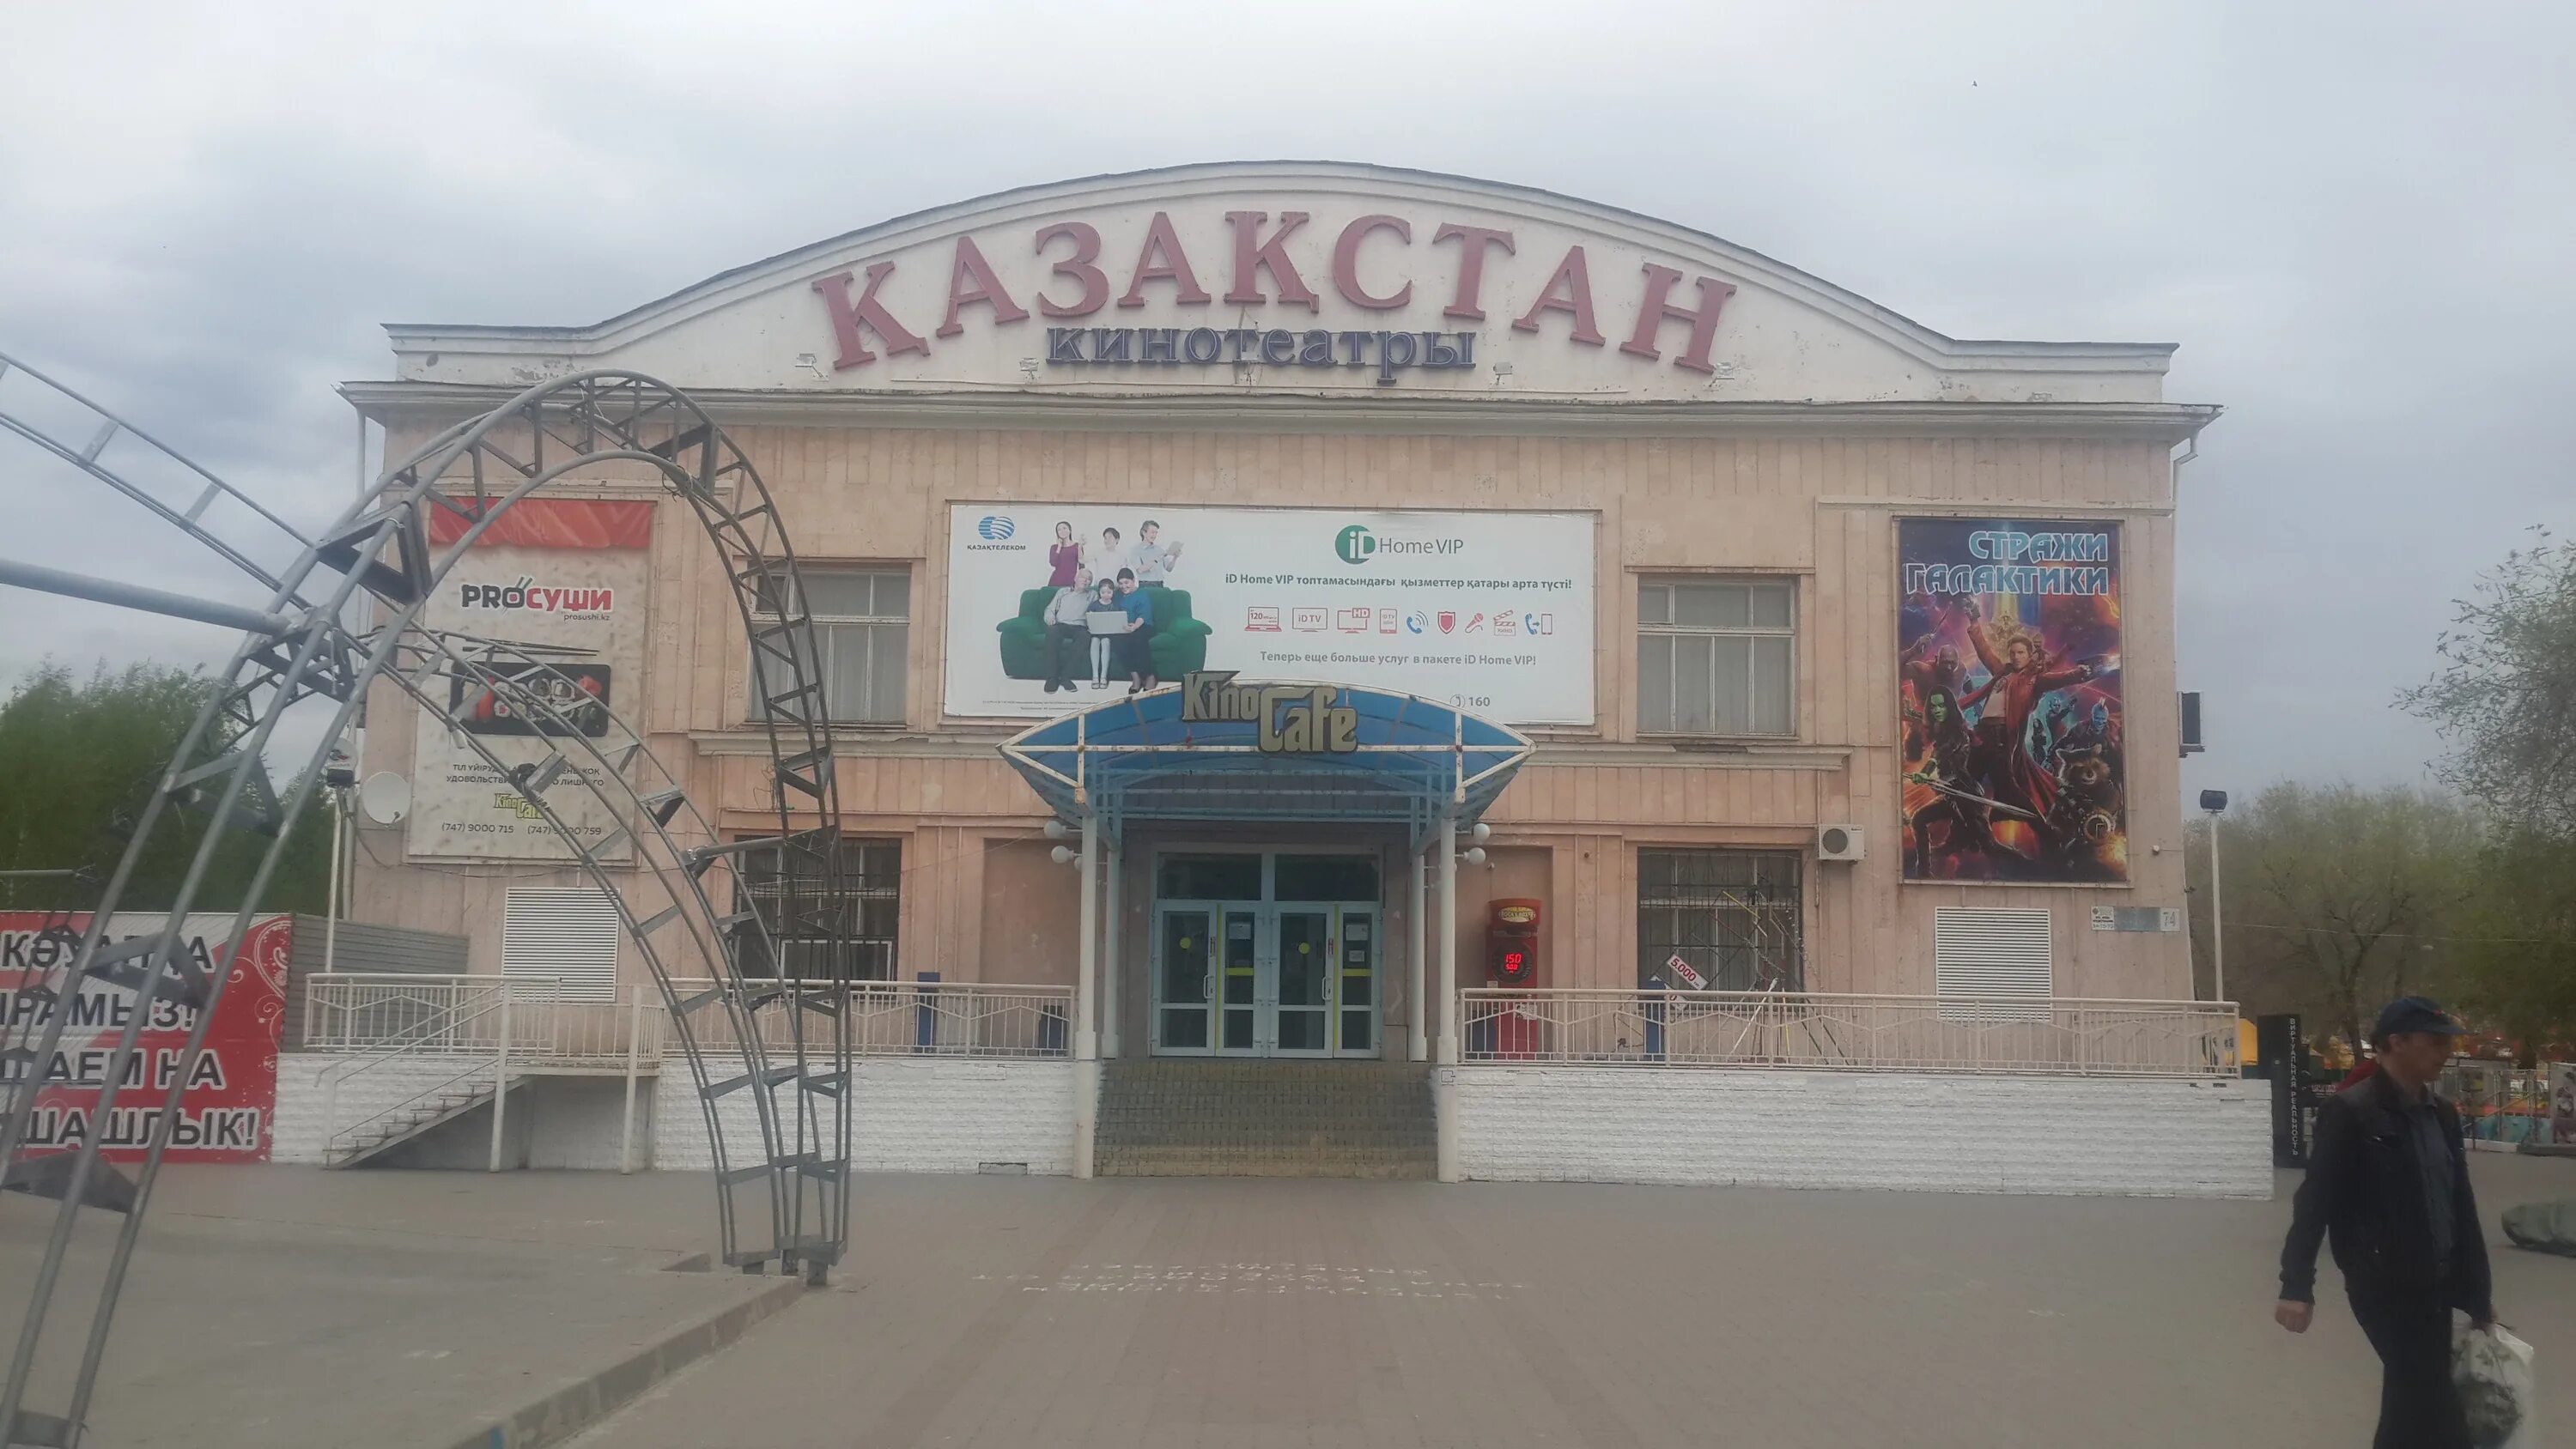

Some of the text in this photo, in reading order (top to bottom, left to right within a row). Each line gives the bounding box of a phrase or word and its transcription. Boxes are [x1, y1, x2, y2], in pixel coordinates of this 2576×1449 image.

[811, 211, 1738, 375] ҚАЗАҚСТАН
[1045, 326, 1477, 385] кинотеатры
[1379, 537, 1434, 554] Home
[1436, 539, 1464, 555] VIP
[1969, 530, 2108, 564] СТРАЖИ
[1225, 573, 1572, 591] iD Home VIP топтамасындағы қызметтер қатары арта түсті!
[1905, 563, 2109, 596] ГАЛАКТИКИ
[1352, 609, 1369, 618] HD
[1260, 652, 1303, 663] Теперь
[1304, 653, 1327, 664] еще
[1331, 652, 1376, 664] больше
[1378, 654, 1409, 665] услуг
[1422, 655, 1461, 664] пакете
[1464, 654, 1476, 664] iD
[1479, 655, 1512, 665] Home
[1514, 656, 1537, 666] VIP!
[1467, 697, 1491, 707] 160
[1182, 670, 1358, 753] Kino Cafe
[447, 775, 513, 784] УДОВОЛЬСТВИ
[441, 824, 465, 833] (747)
[527, 825, 551, 834] (747)
[1670, 958, 1697, 981] 5.000
[2288, 1018, 2299, 1155] ВИРТУАЛЬНАЯ РЕАЛЬНОСТЬ
